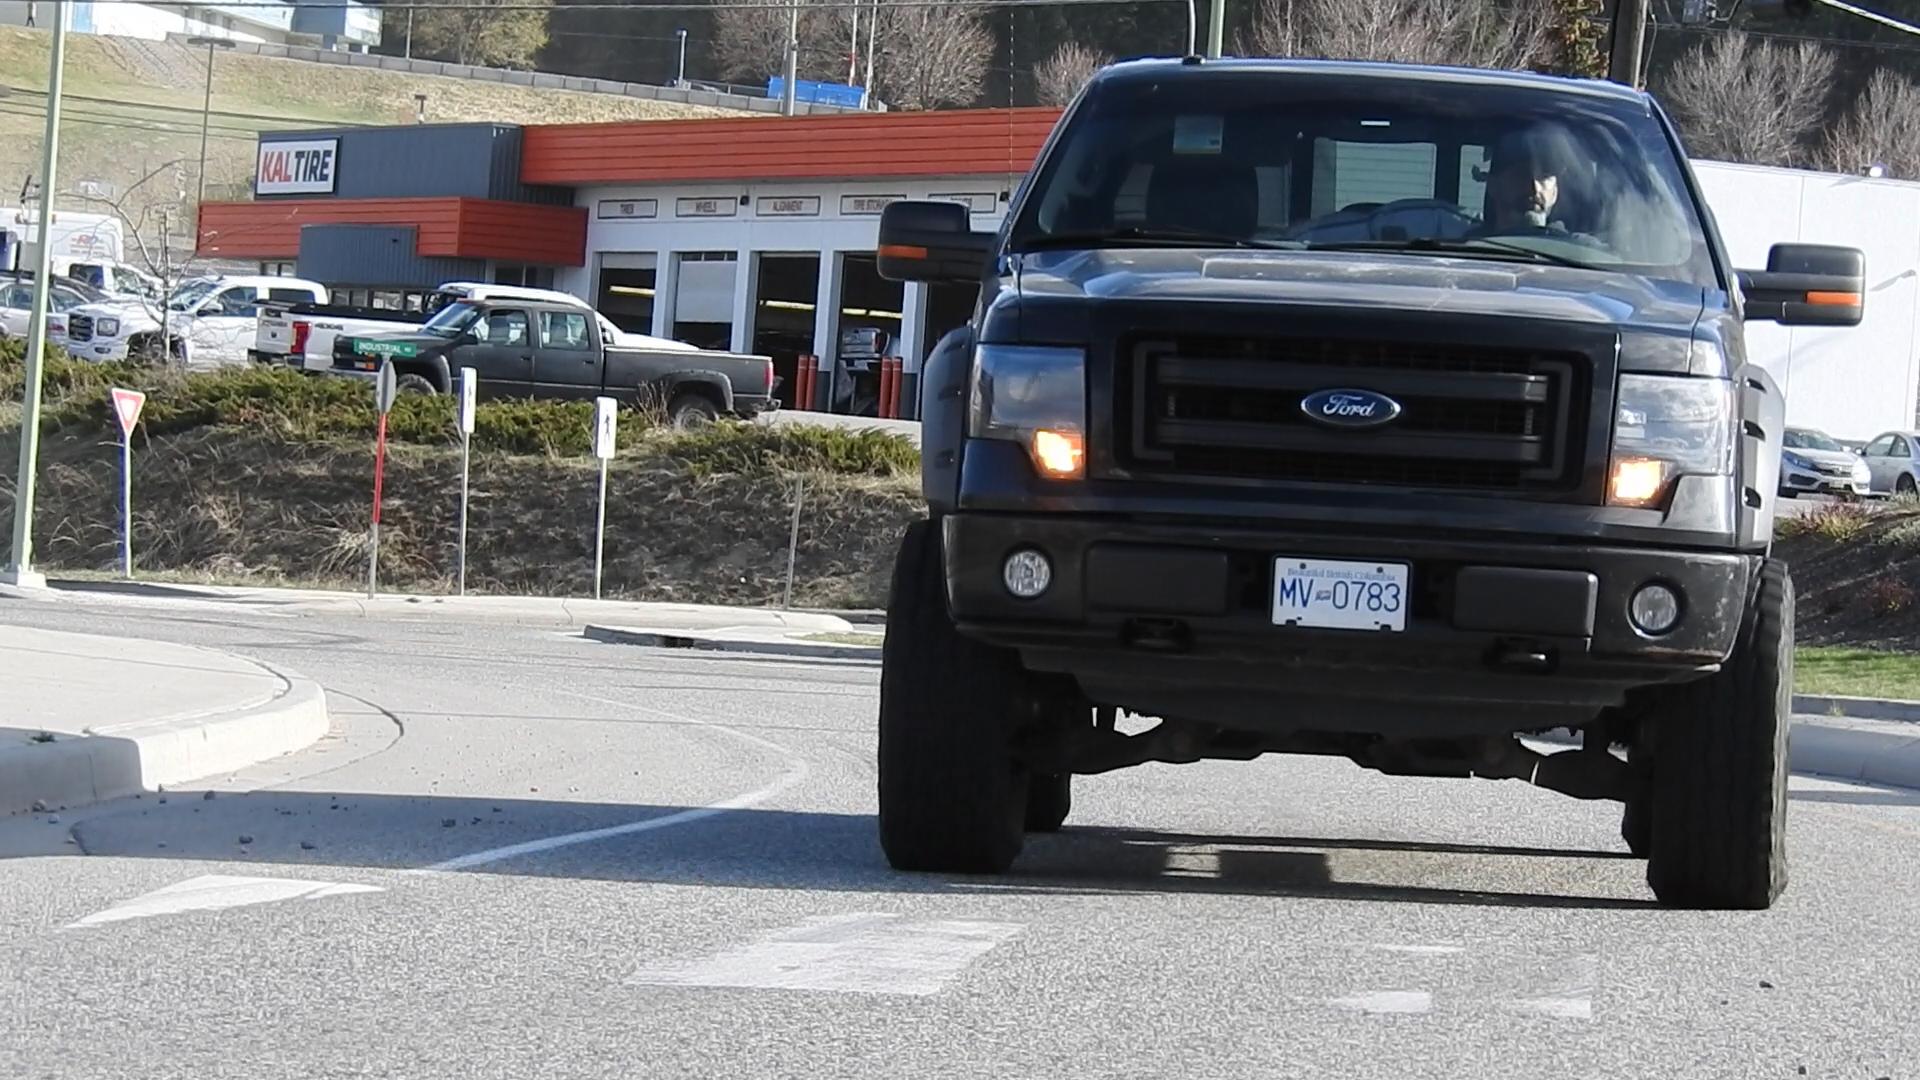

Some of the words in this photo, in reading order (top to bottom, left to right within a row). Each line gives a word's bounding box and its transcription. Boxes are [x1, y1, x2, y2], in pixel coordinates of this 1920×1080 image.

[261, 152, 292, 182] KAL
[294, 149, 333, 182] TIRE
[695, 200, 717, 213] WHEELS
[772, 201, 804, 212] ALIGNMENT
[359, 342, 402, 354] INDUSTRIAL
[1322, 393, 1376, 416] Ford
[1279, 577, 1314, 608] MV
[1332, 580, 1401, 612] 0783
